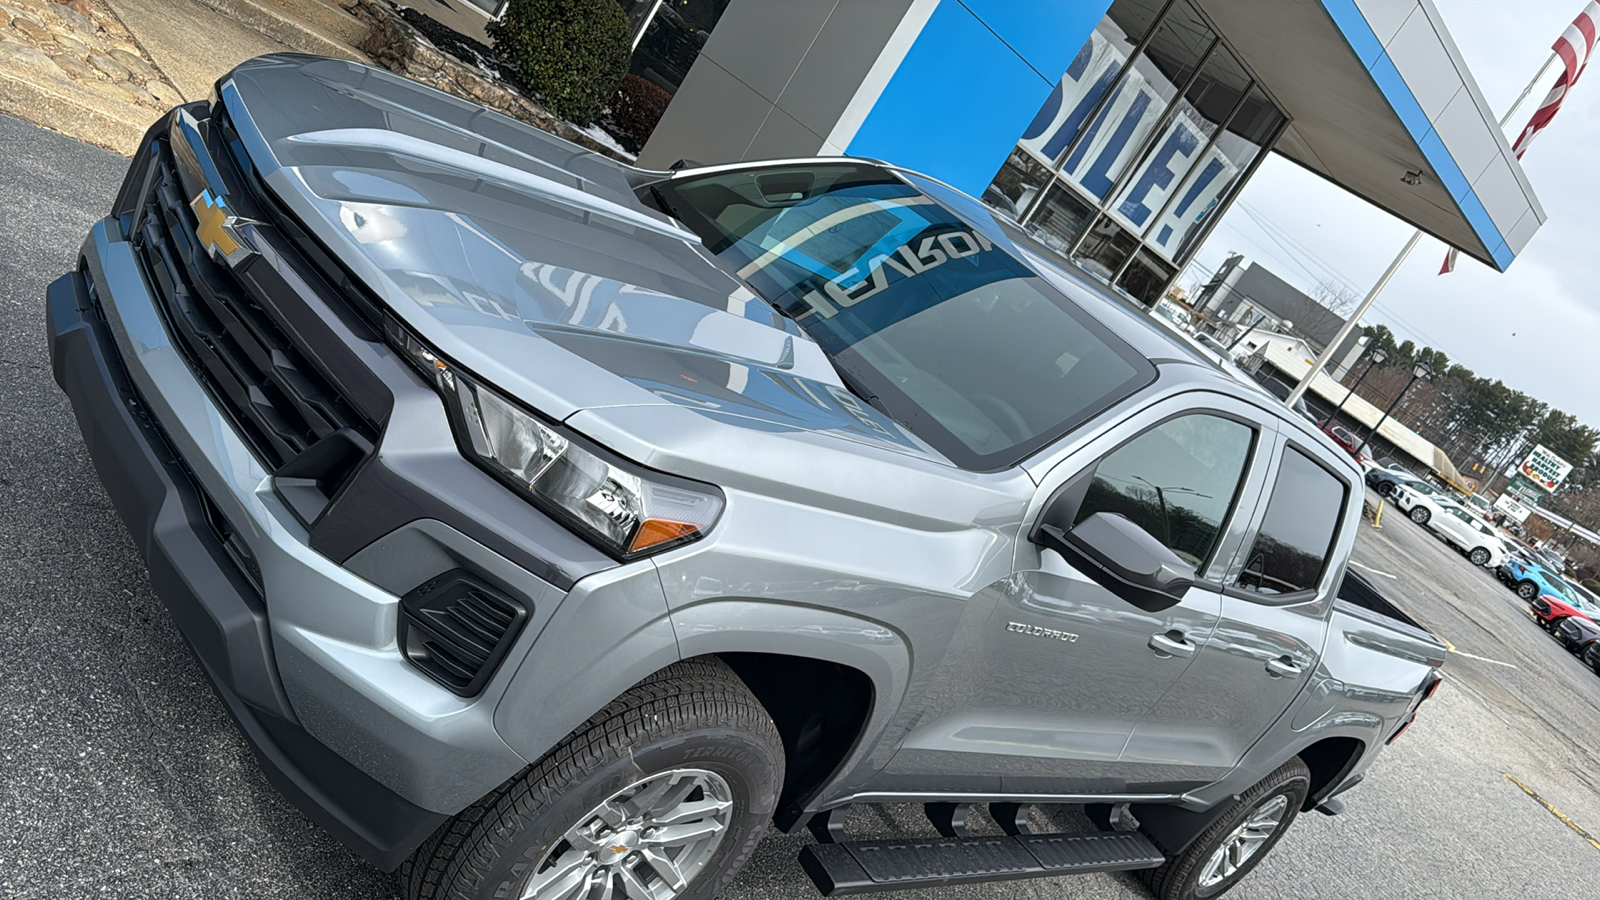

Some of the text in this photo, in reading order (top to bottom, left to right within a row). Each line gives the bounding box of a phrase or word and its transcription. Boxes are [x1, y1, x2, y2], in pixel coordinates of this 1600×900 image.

[1531, 457, 1561, 478] HARVEST
[1532, 450, 1561, 470] HEALTHY
[1530, 463, 1560, 485] PRODUCE
[1005, 621, 1079, 643] COLORADO
